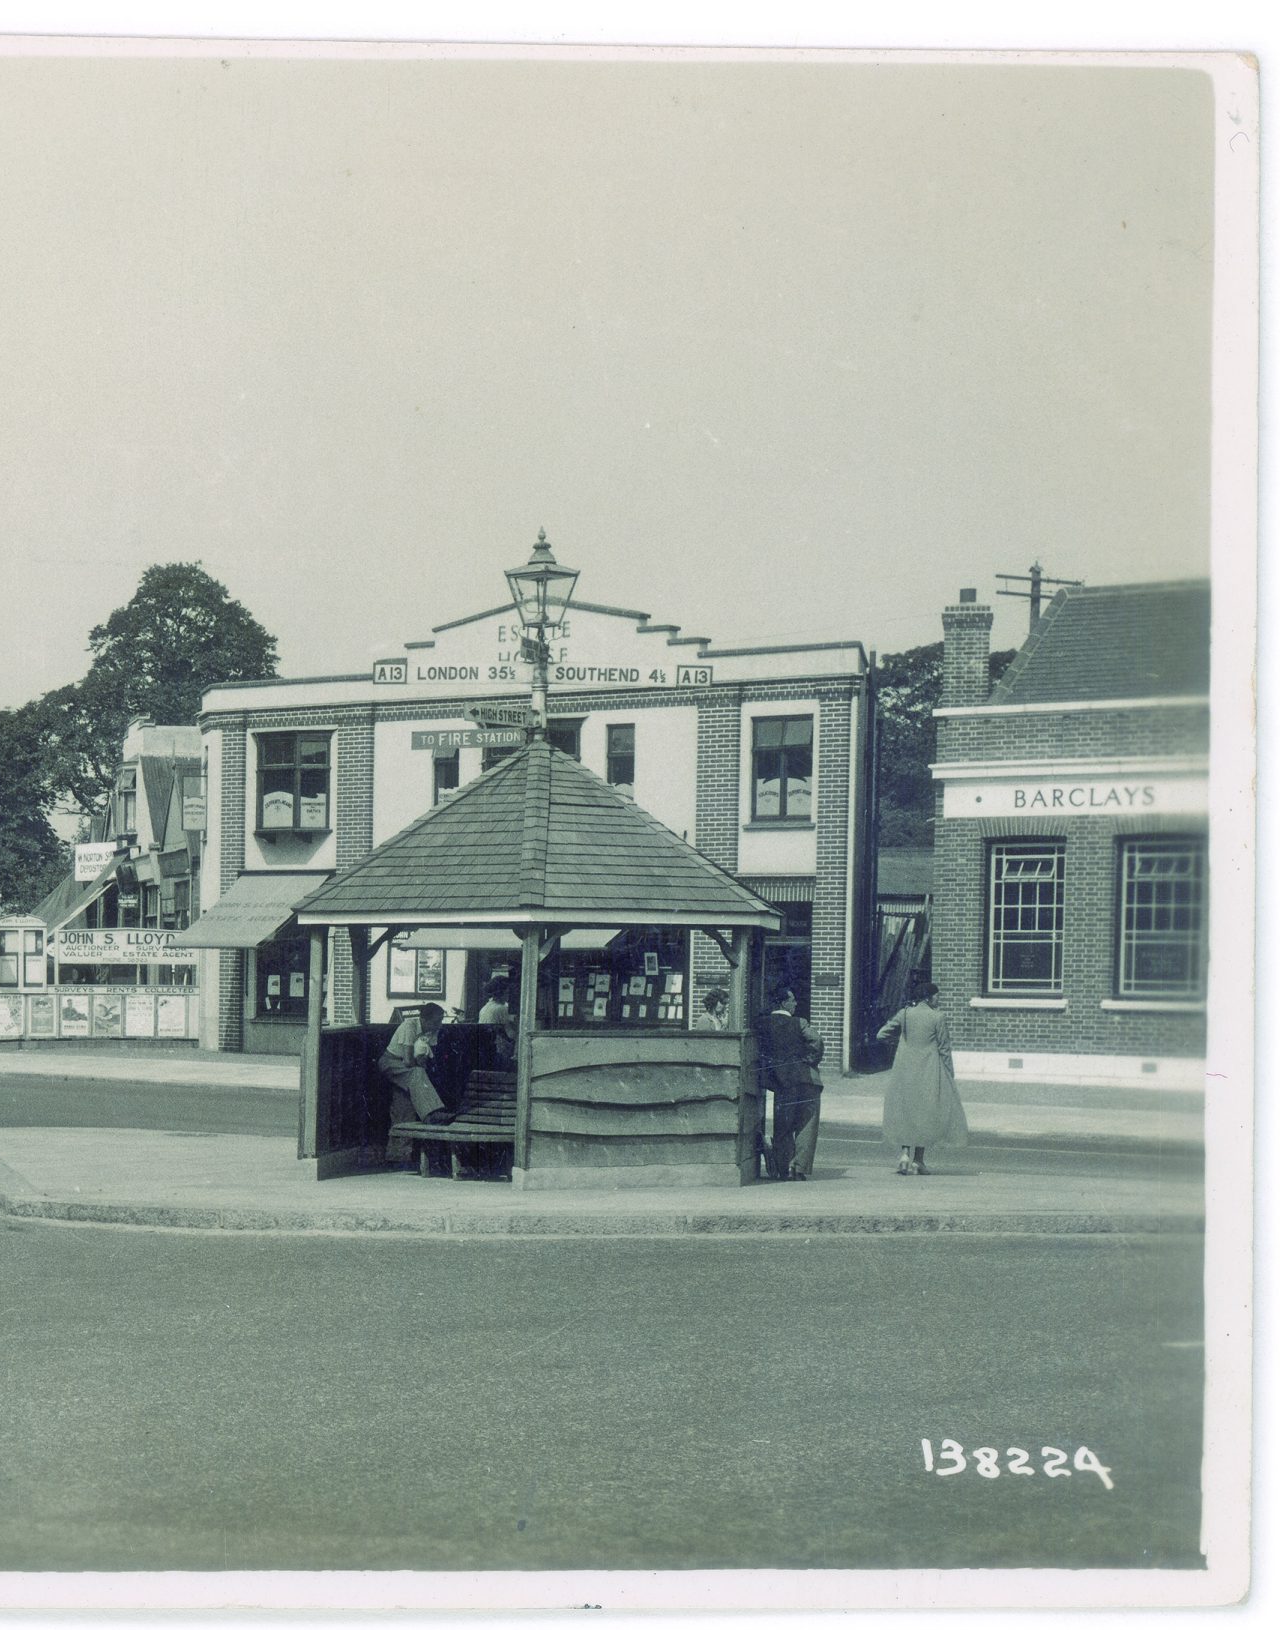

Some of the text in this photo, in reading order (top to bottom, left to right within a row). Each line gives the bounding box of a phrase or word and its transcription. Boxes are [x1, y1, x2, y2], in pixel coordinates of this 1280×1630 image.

[417, 665, 479, 681] LONDON
[555, 665, 640, 683] SOUTHEND
[481, 707, 526, 724] HIGH STREET
[420, 731, 520, 746] TO FIRE STATION
[1013, 786, 1156, 809] BARCLAYS
[60, 932, 94, 945] JOHN
[127, 932, 175, 945] LLOYD
